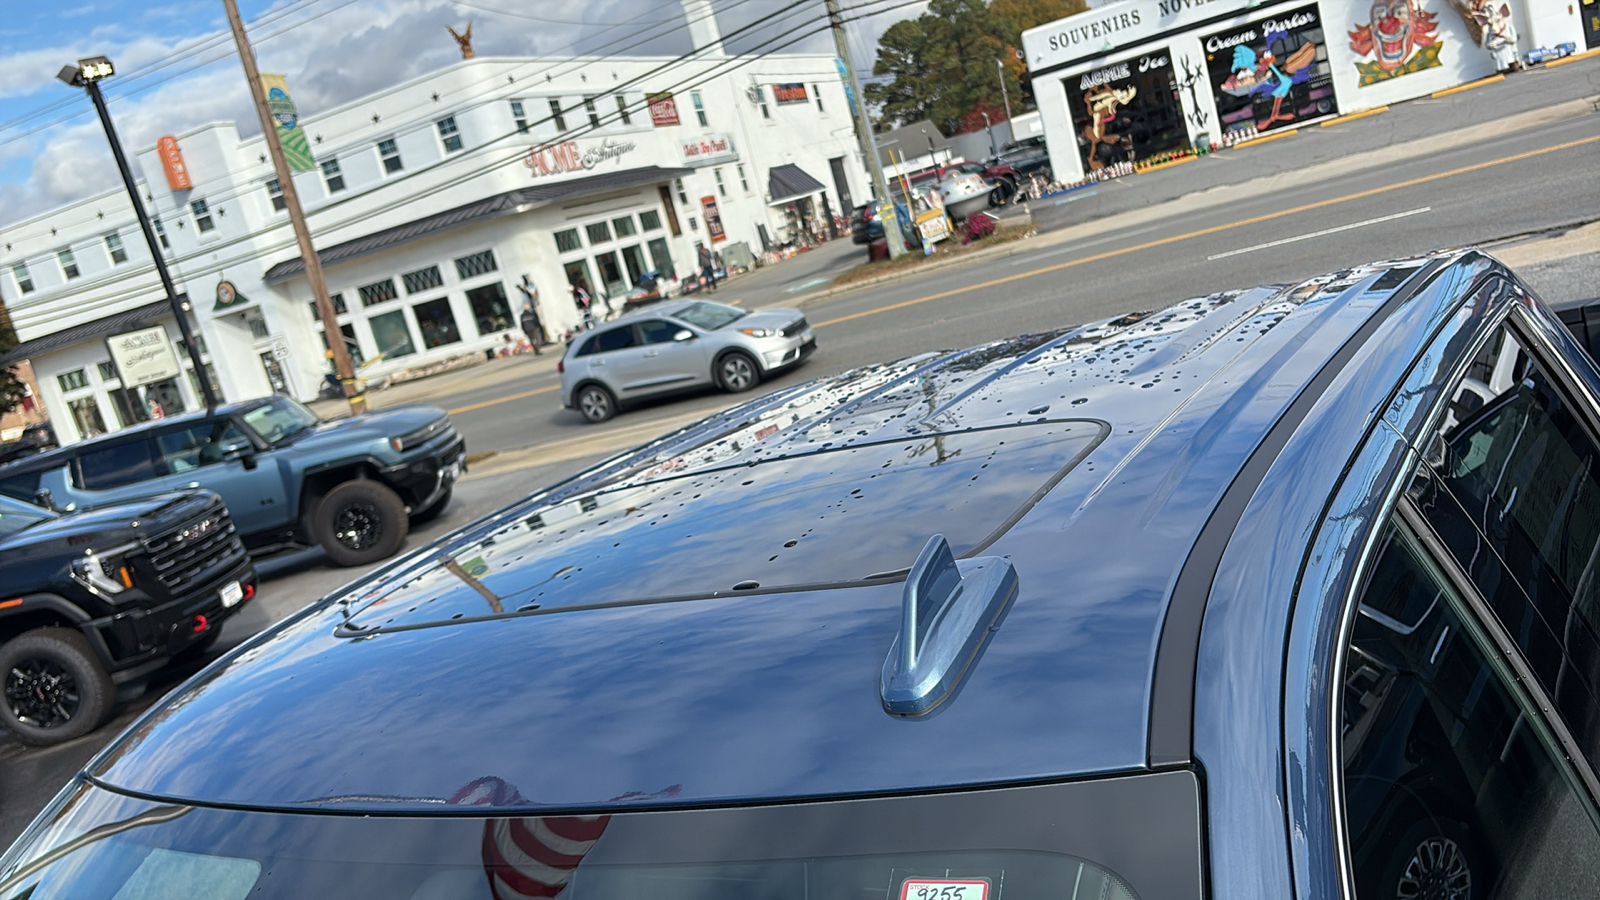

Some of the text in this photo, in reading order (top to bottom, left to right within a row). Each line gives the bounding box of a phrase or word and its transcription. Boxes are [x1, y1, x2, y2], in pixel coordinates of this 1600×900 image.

[1049, 10, 1141, 51] SOUVENIRS
[1206, 11, 1317, 53] Cream Parlor
[1080, 56, 1169, 91] ACME Ice
[523, 140, 584, 178] ACME
[917, 886, 967, 900] 9255
